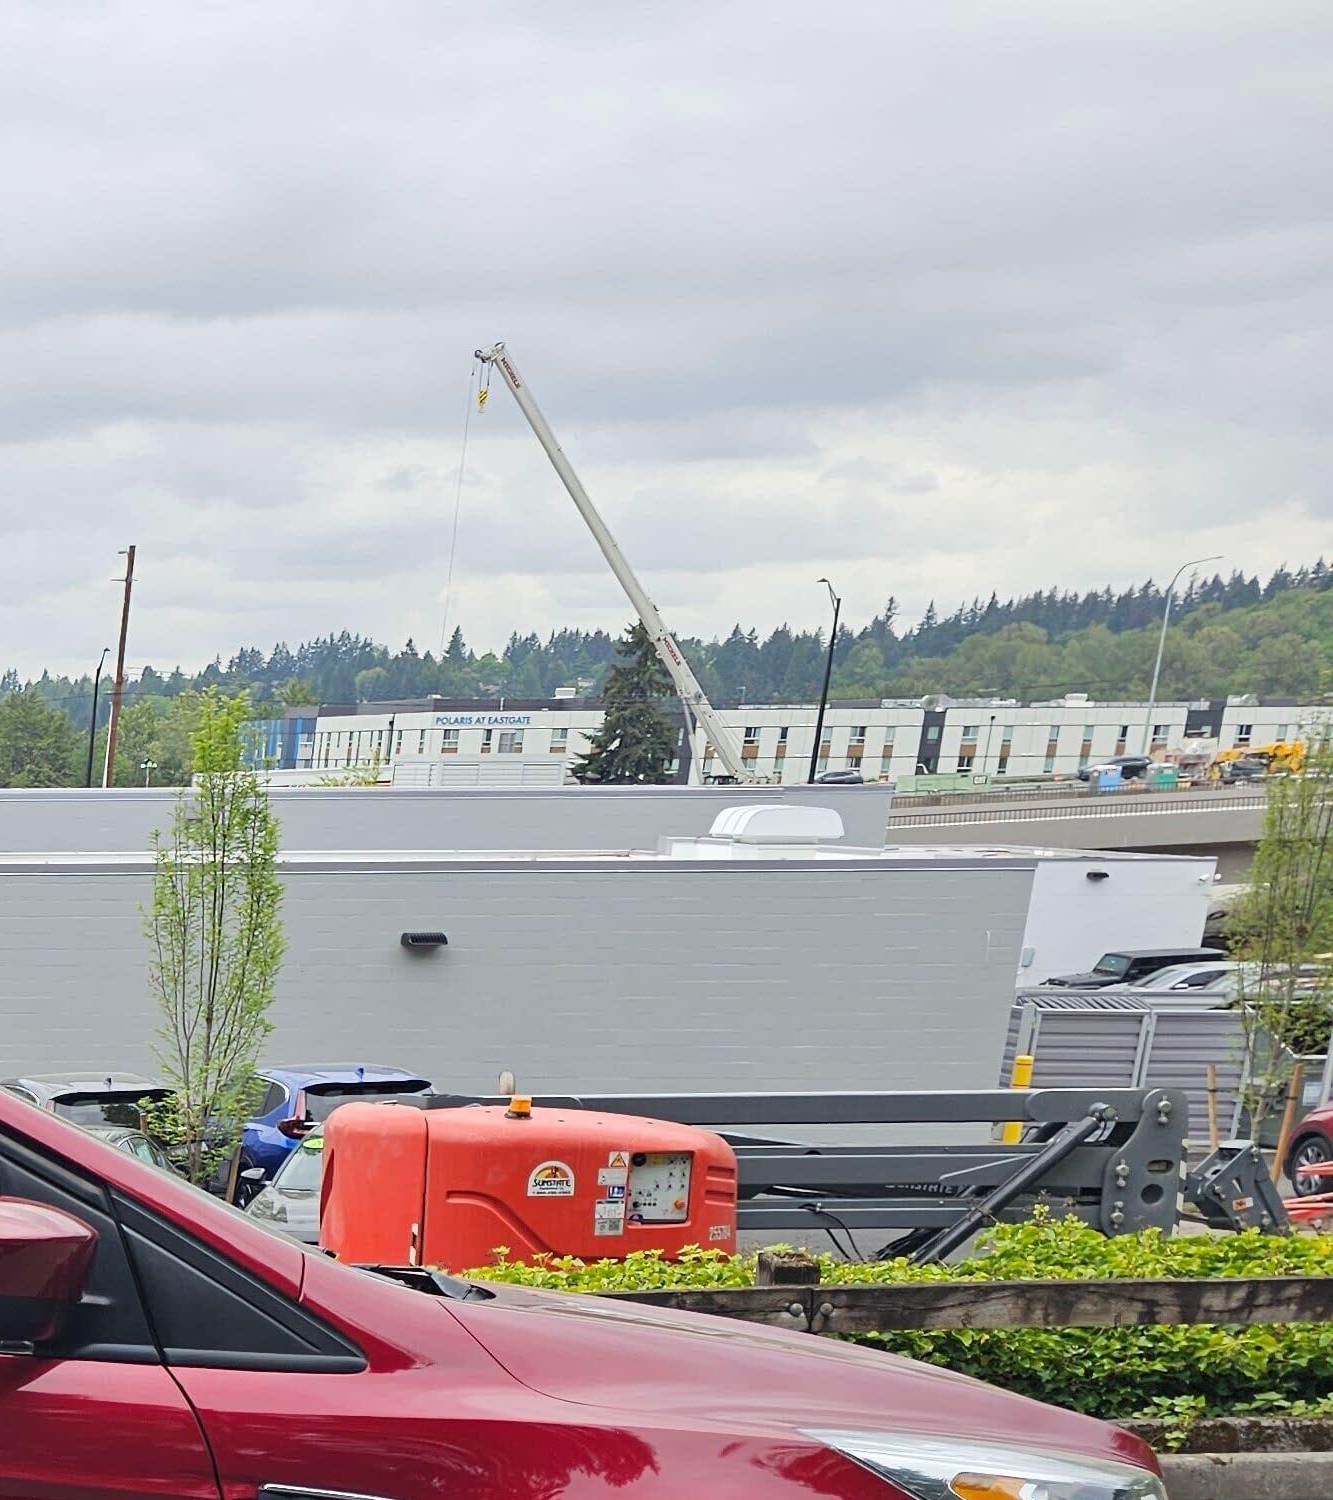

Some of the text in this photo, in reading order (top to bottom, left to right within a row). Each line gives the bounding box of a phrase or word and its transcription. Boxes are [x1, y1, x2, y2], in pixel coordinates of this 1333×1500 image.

[436, 716, 531, 725] POLARIS AT EASTGATE
